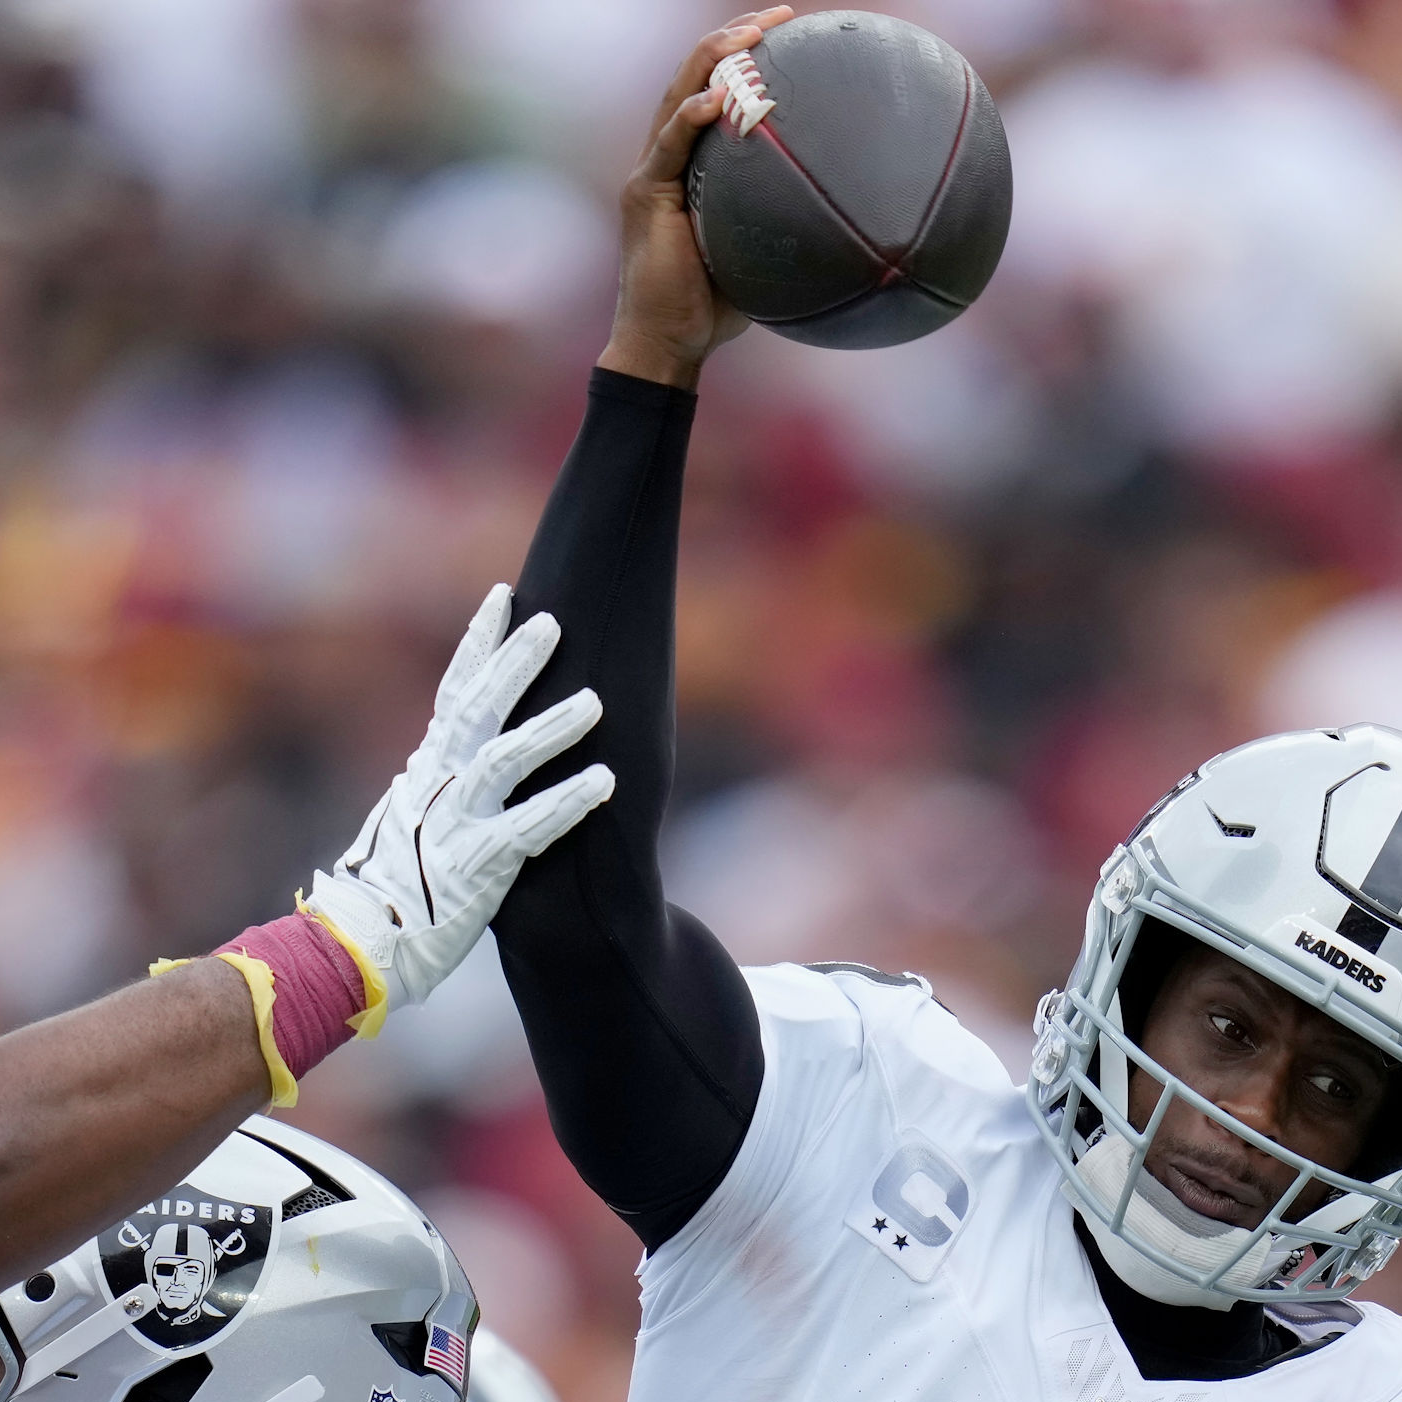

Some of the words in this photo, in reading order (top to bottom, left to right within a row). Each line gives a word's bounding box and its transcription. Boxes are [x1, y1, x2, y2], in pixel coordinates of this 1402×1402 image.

[1295, 930, 1387, 993] RAIDERS
[136, 1199, 256, 1225] AIDERS
[872, 1141, 969, 1246] C
